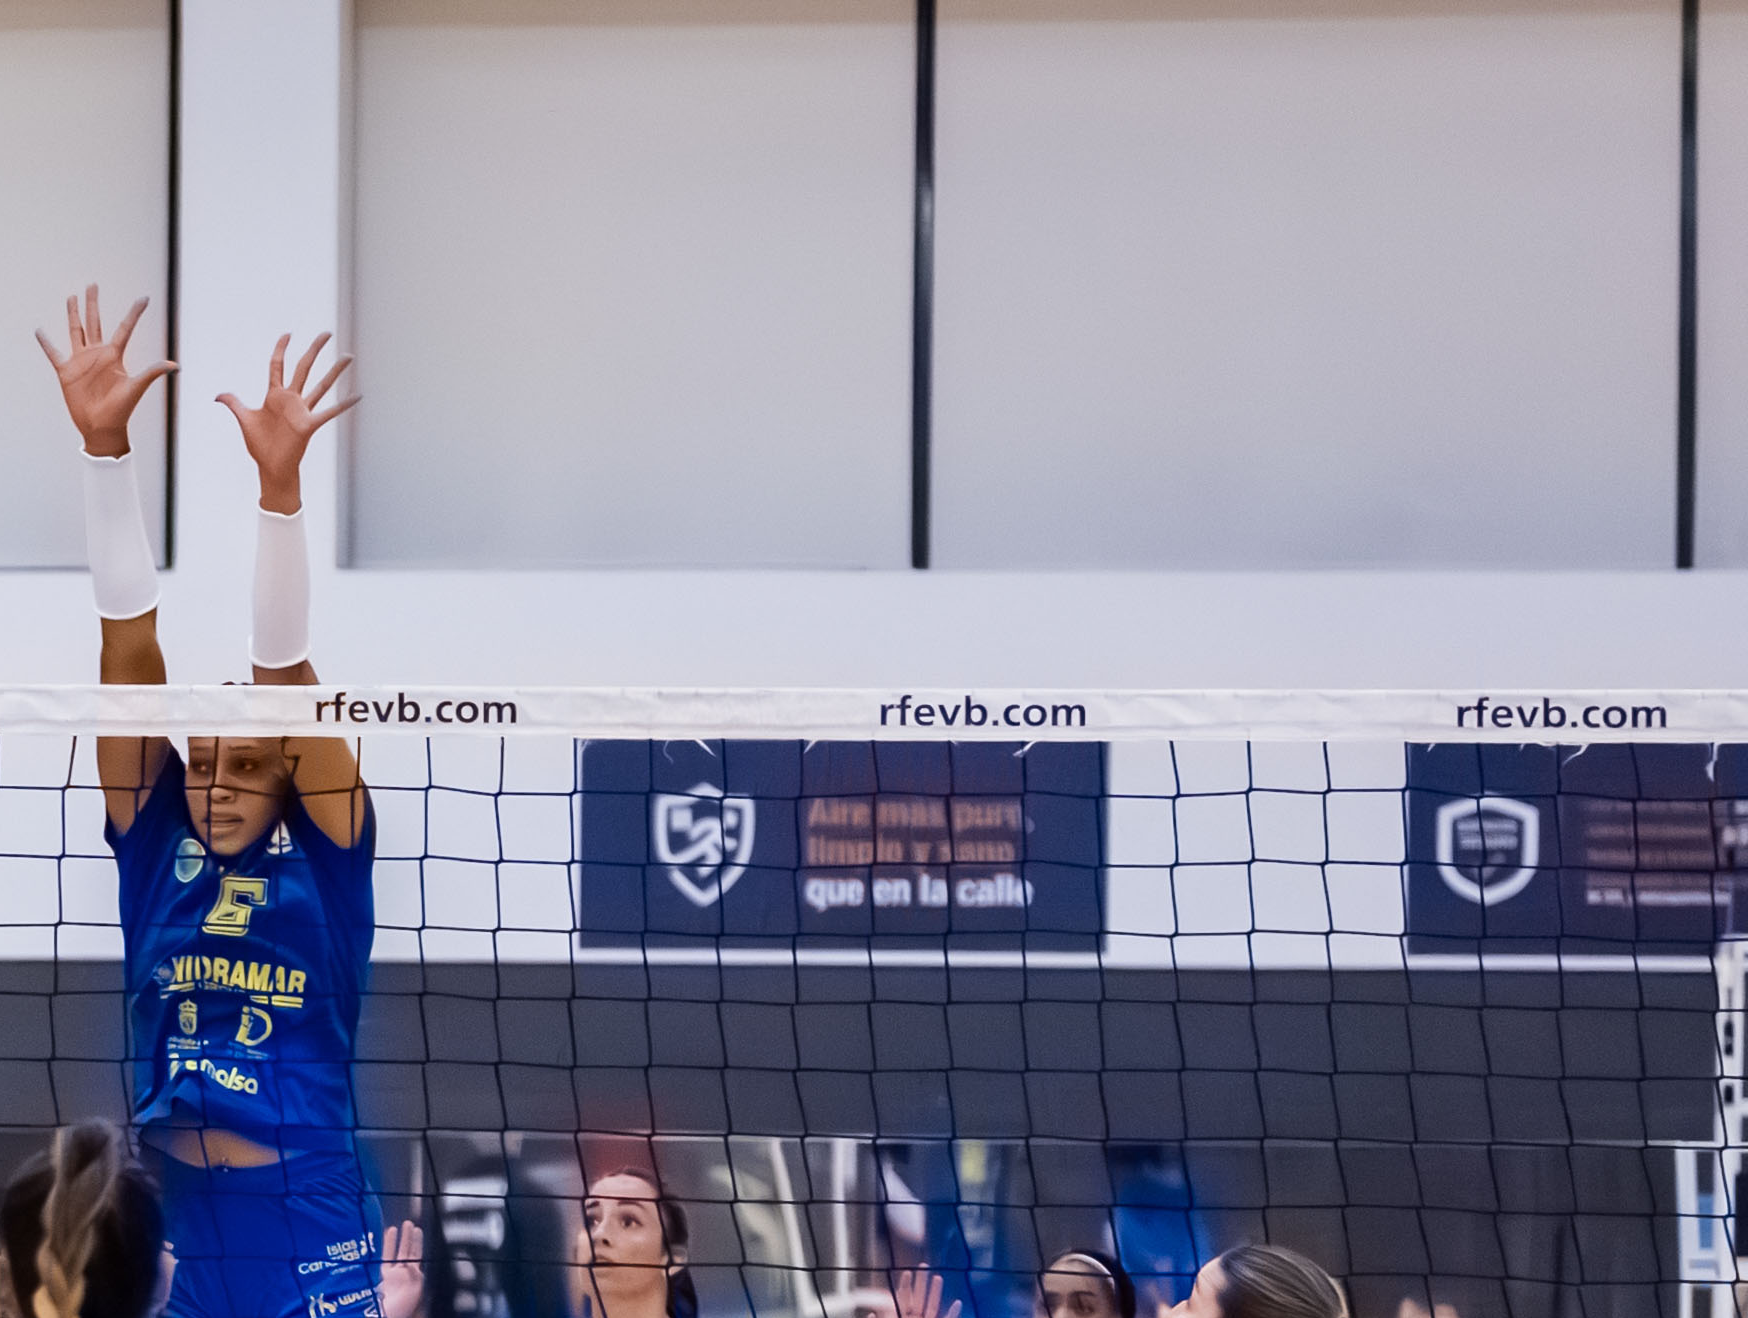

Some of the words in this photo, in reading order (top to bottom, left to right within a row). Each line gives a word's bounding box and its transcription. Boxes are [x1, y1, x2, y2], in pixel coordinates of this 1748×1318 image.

[315, 692, 517, 724] rfevb.com
[880, 695, 1086, 727] rfevb.com
[1456, 697, 1667, 729] rfevb.com
[806, 877, 865, 912] que
[872, 878, 911, 907] en
[919, 873, 948, 907] la
